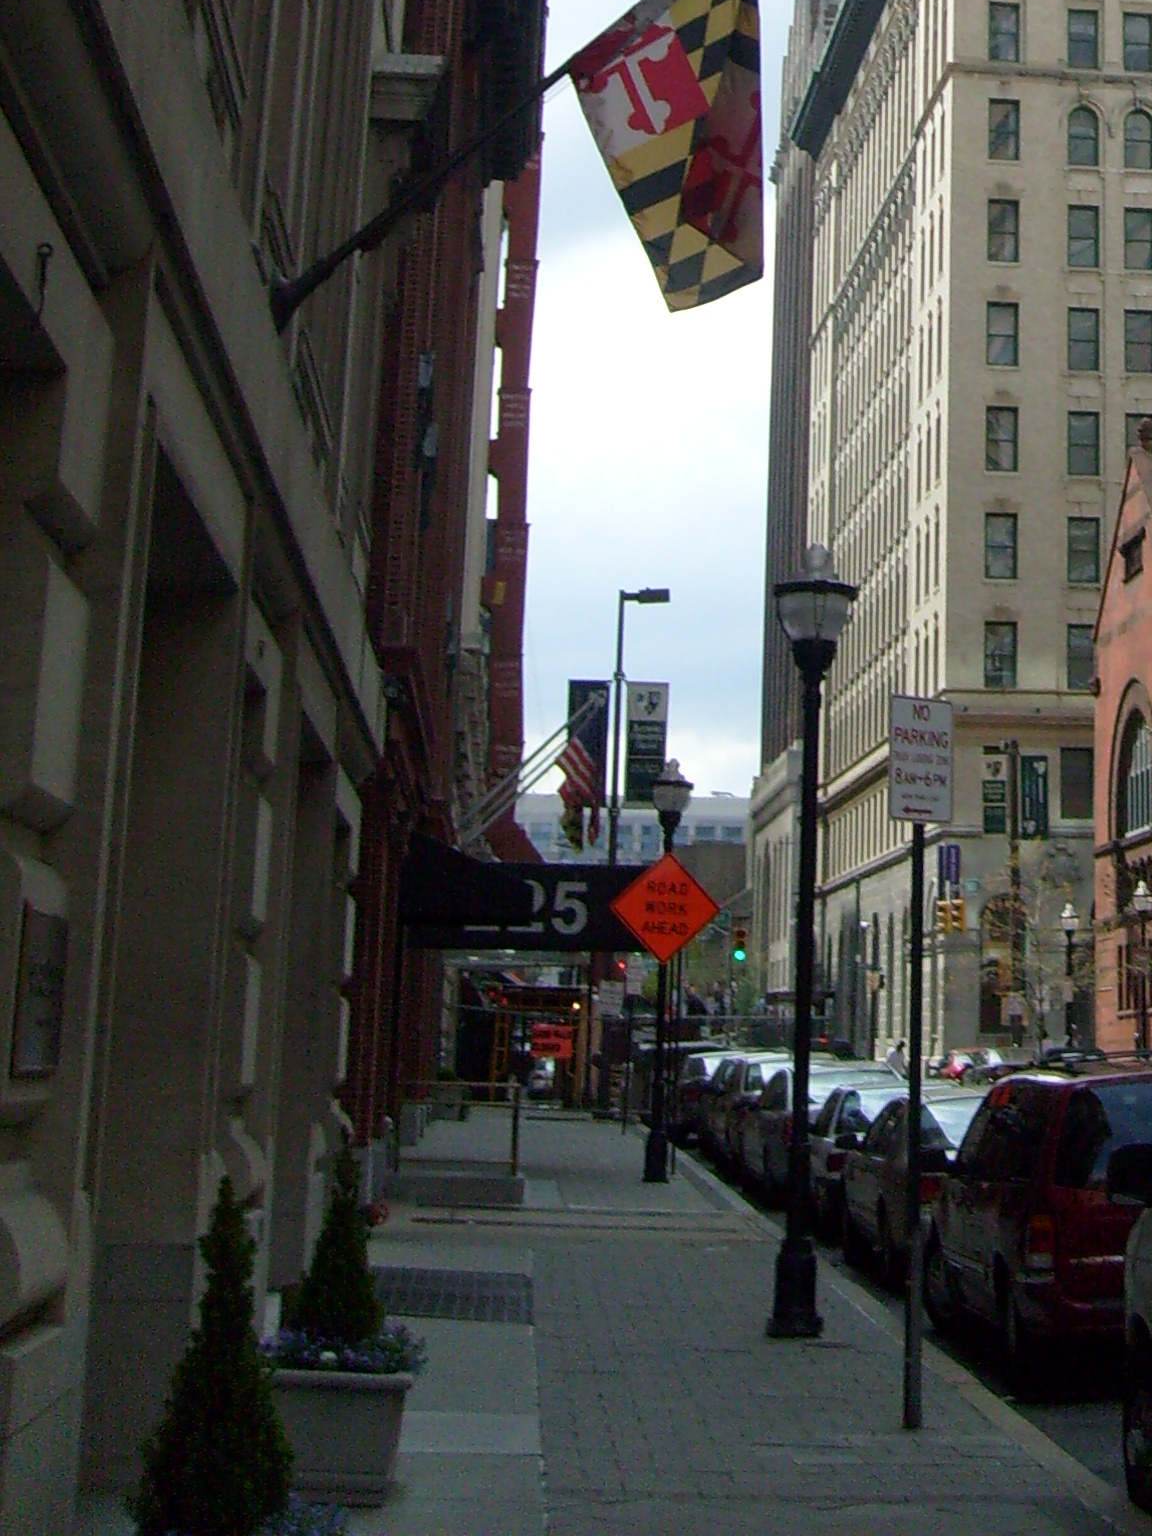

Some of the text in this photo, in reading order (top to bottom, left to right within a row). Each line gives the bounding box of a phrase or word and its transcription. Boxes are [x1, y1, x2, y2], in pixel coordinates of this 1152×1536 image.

[912, 703, 931, 722] NO
[894, 726, 949, 749] PARKING
[646, 879, 689, 896] ROAD
[464, 878, 589, 936] 25
[644, 902, 688, 917] WORK
[641, 921, 689, 937] AHEAD
